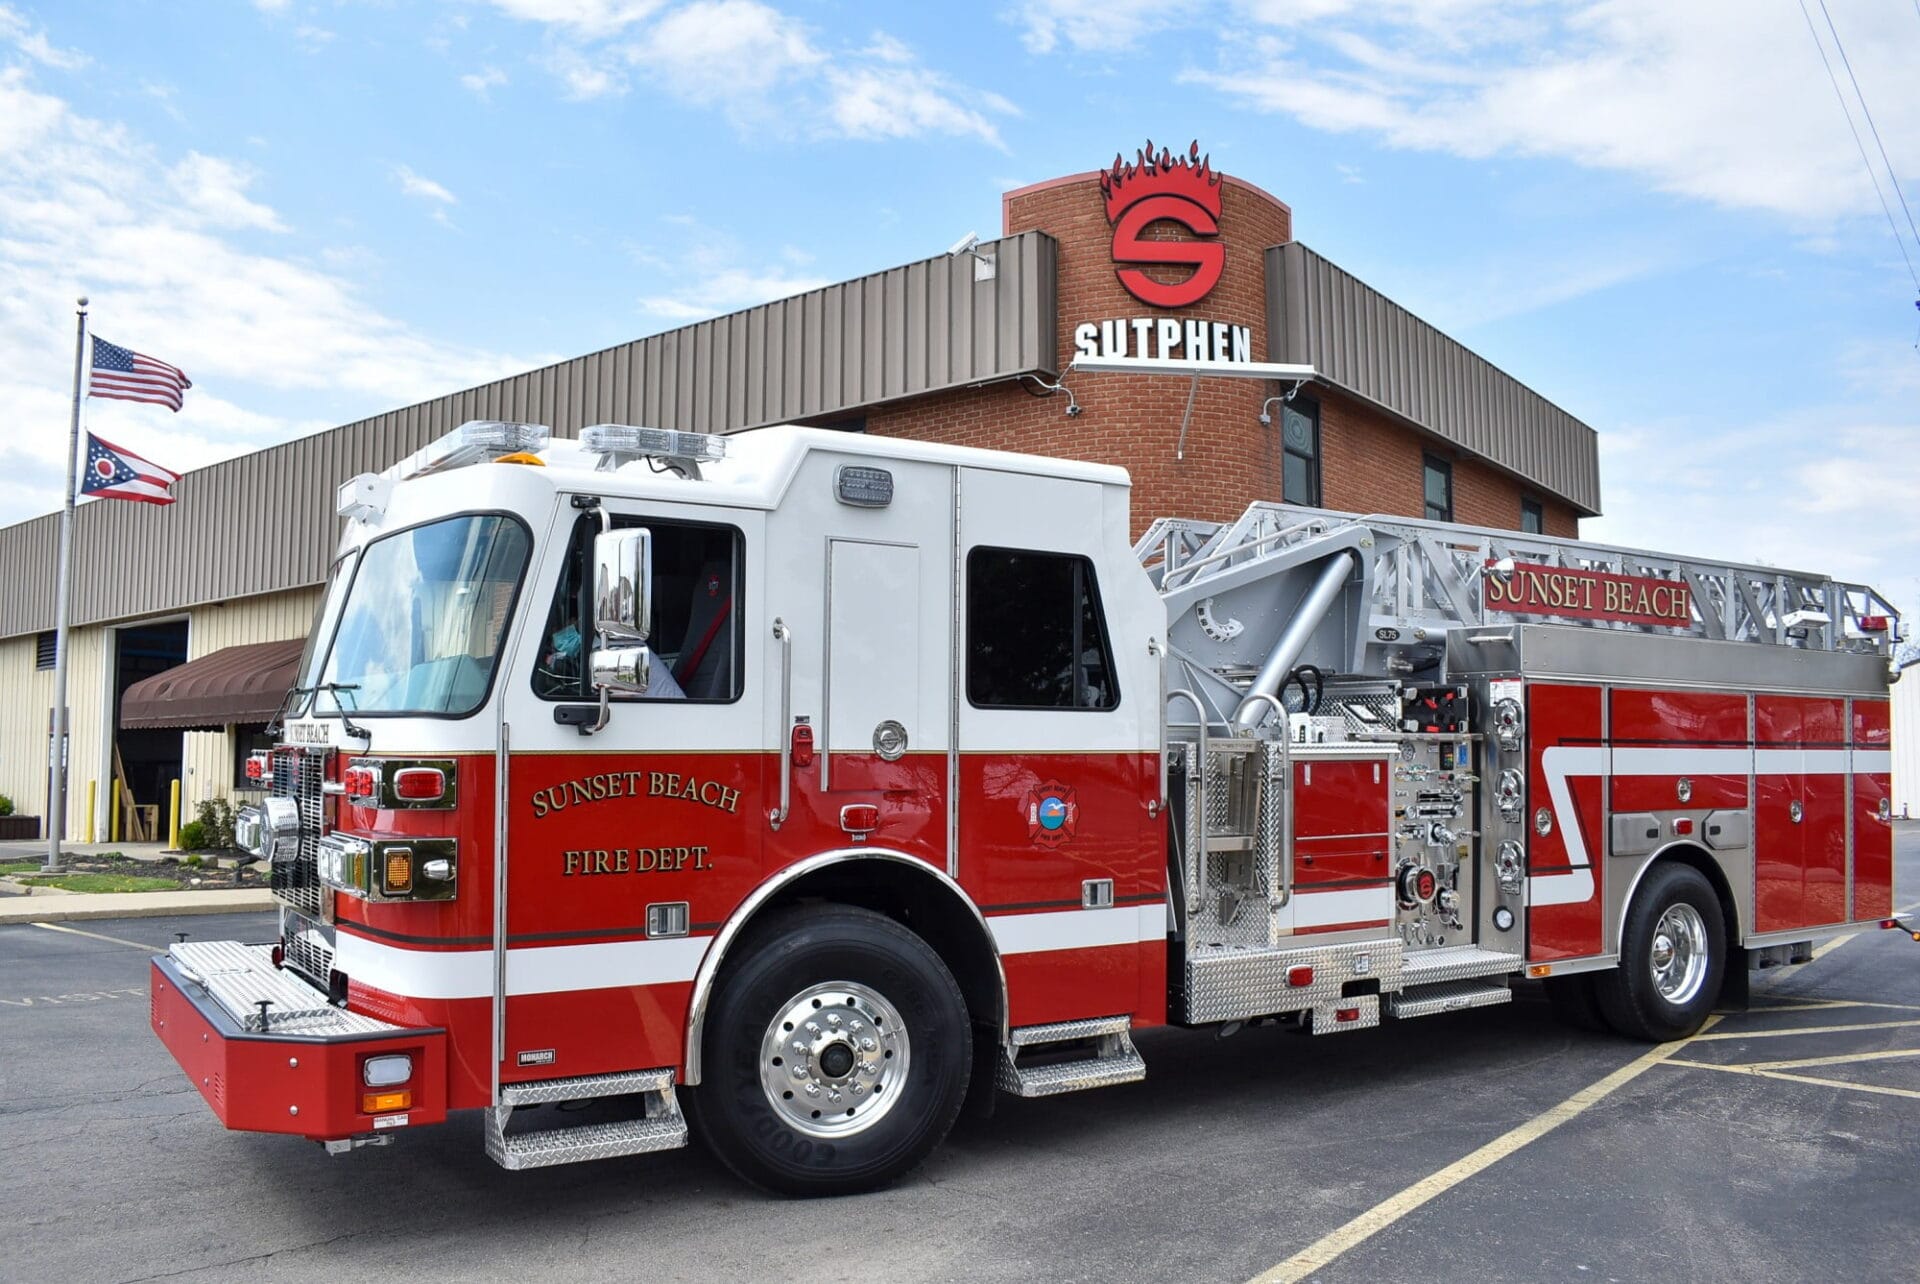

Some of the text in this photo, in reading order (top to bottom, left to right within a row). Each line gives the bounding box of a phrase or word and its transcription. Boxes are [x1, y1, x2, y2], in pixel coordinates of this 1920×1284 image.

[1074, 318, 1250, 362] SUTPHEN
[1489, 570, 1688, 619] SUNSET BEACH
[1379, 630, 1396, 640] SL75
[307, 724, 329, 744] BEACH
[532, 771, 741, 817] SUNSET BEACH
[564, 846, 713, 875] FIRE DEPT.
[521, 1051, 553, 1063] MONARCH
